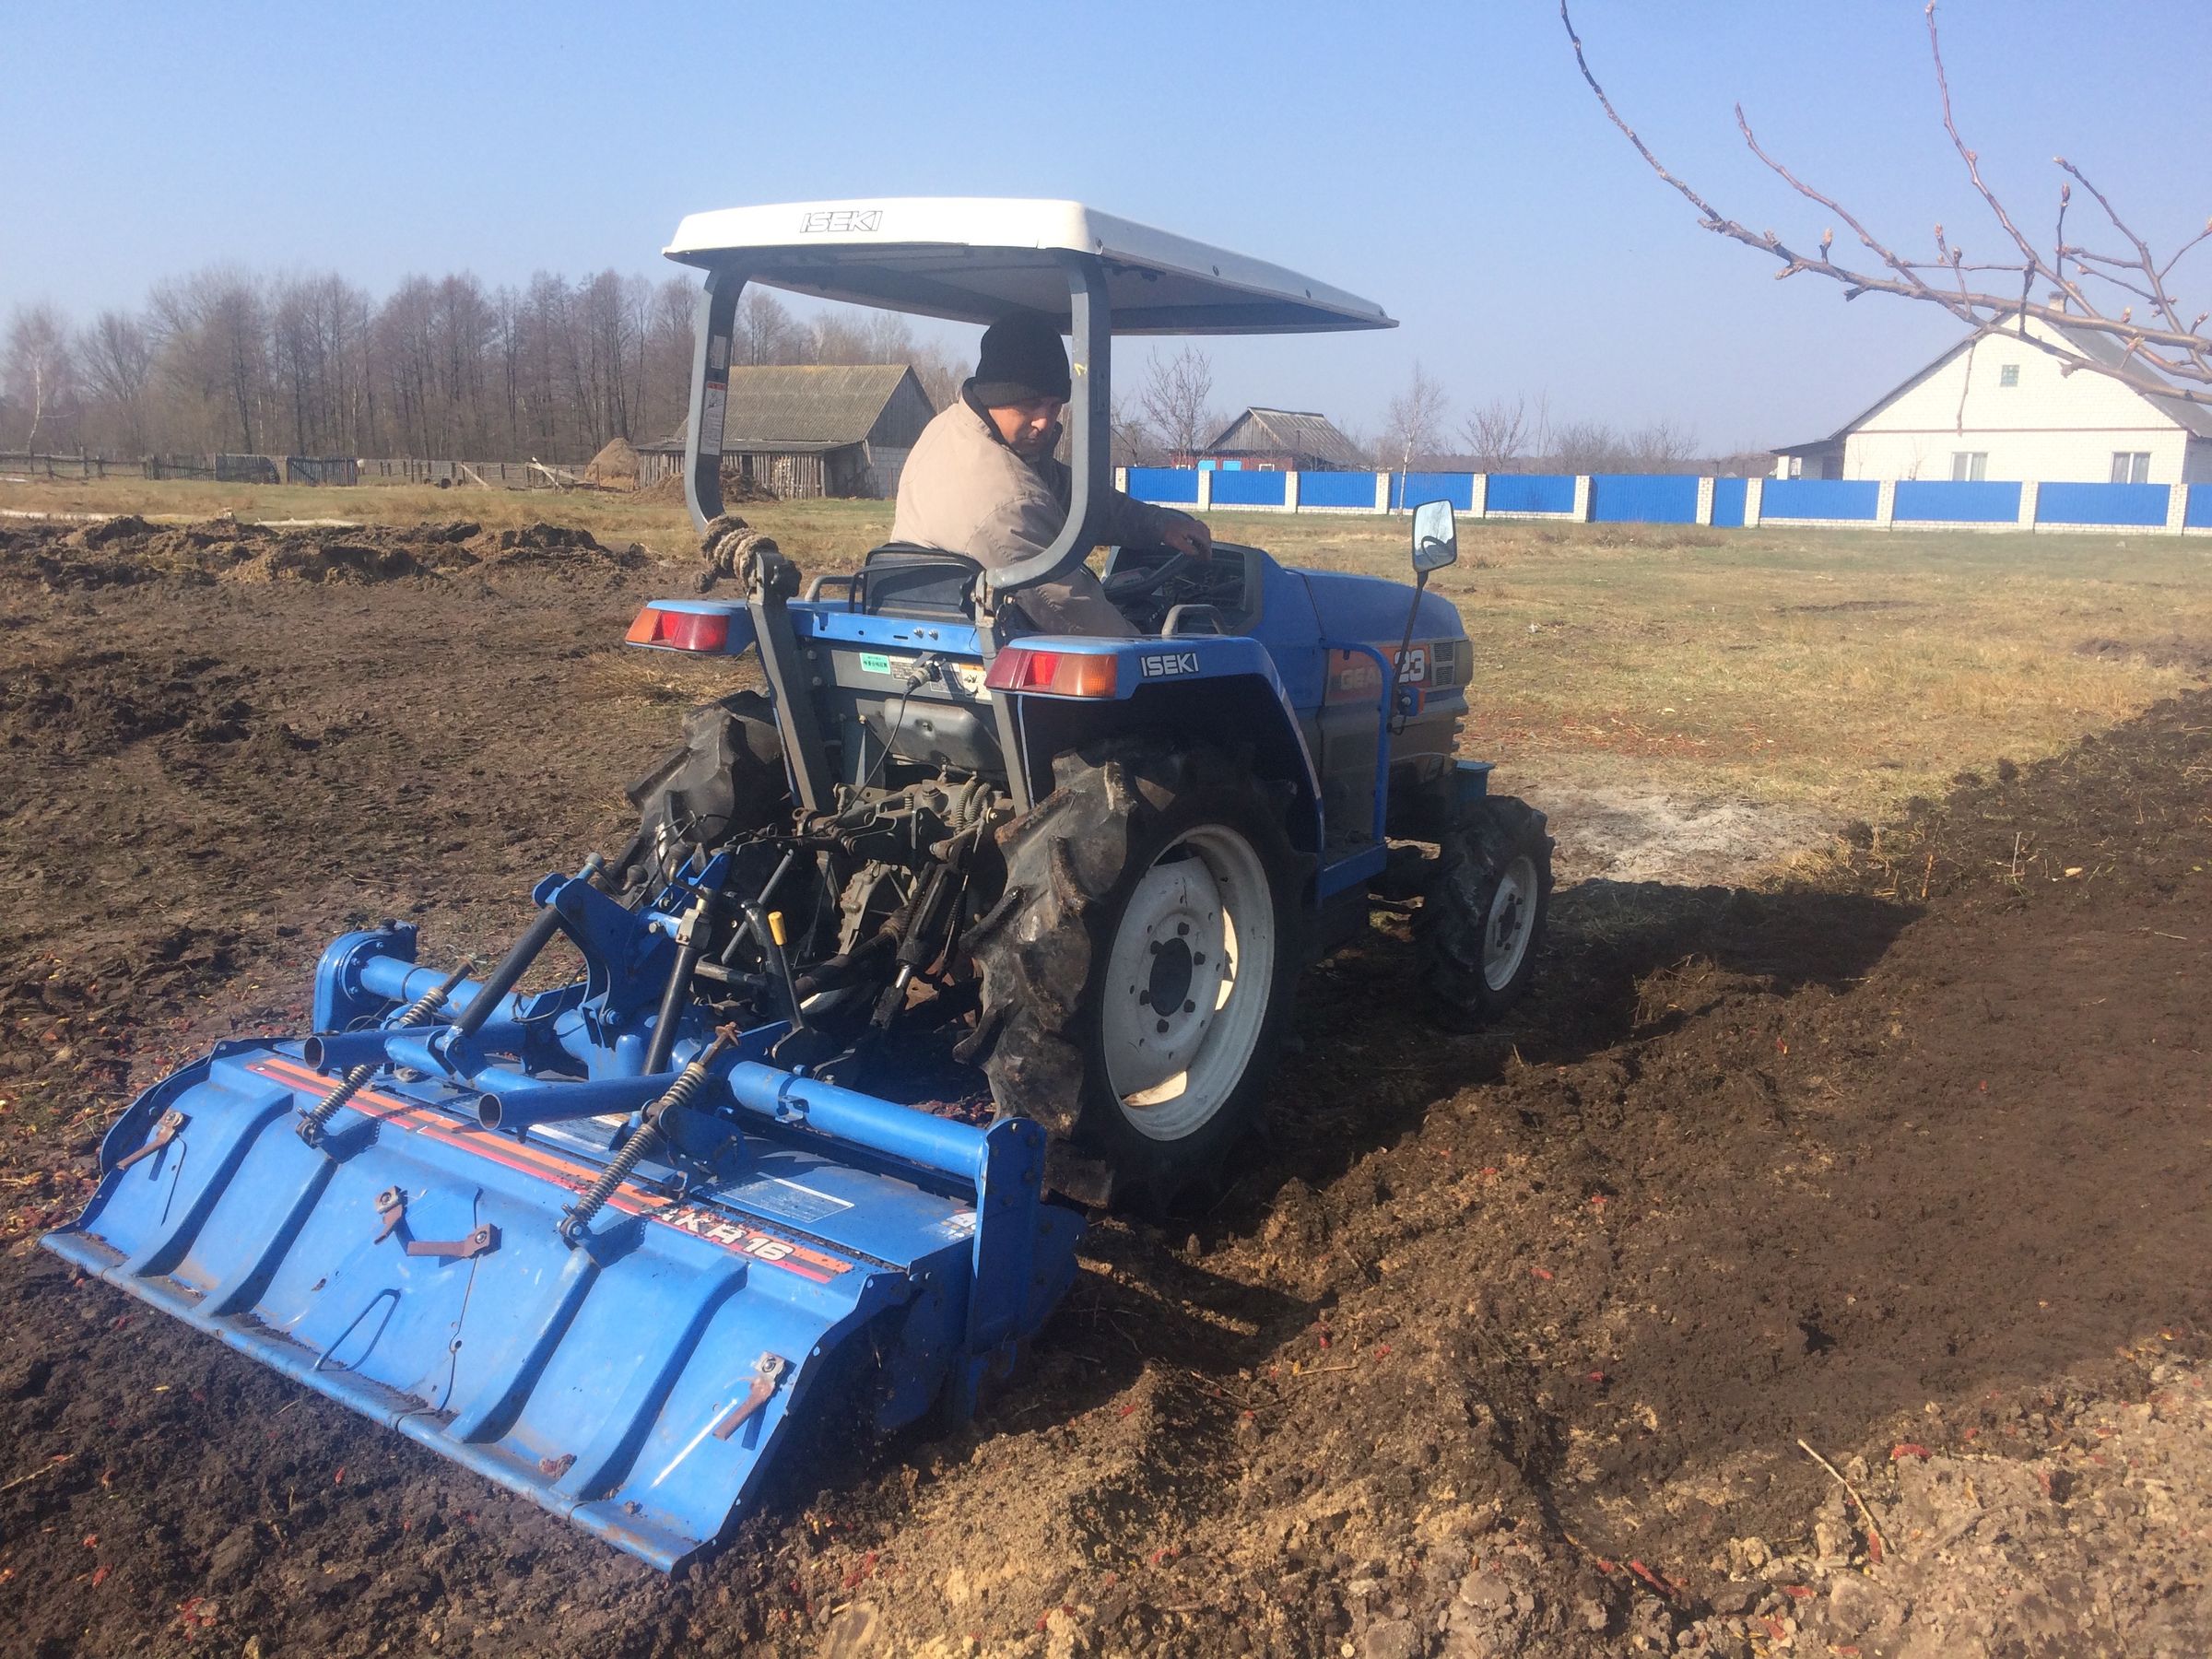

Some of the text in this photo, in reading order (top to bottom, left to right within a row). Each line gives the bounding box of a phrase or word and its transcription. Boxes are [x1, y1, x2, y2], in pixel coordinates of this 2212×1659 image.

[799, 210, 883, 233] ISEKI
[1140, 652, 1199, 677] ISEKI
[1340, 649, 1425, 690] GEA 23
